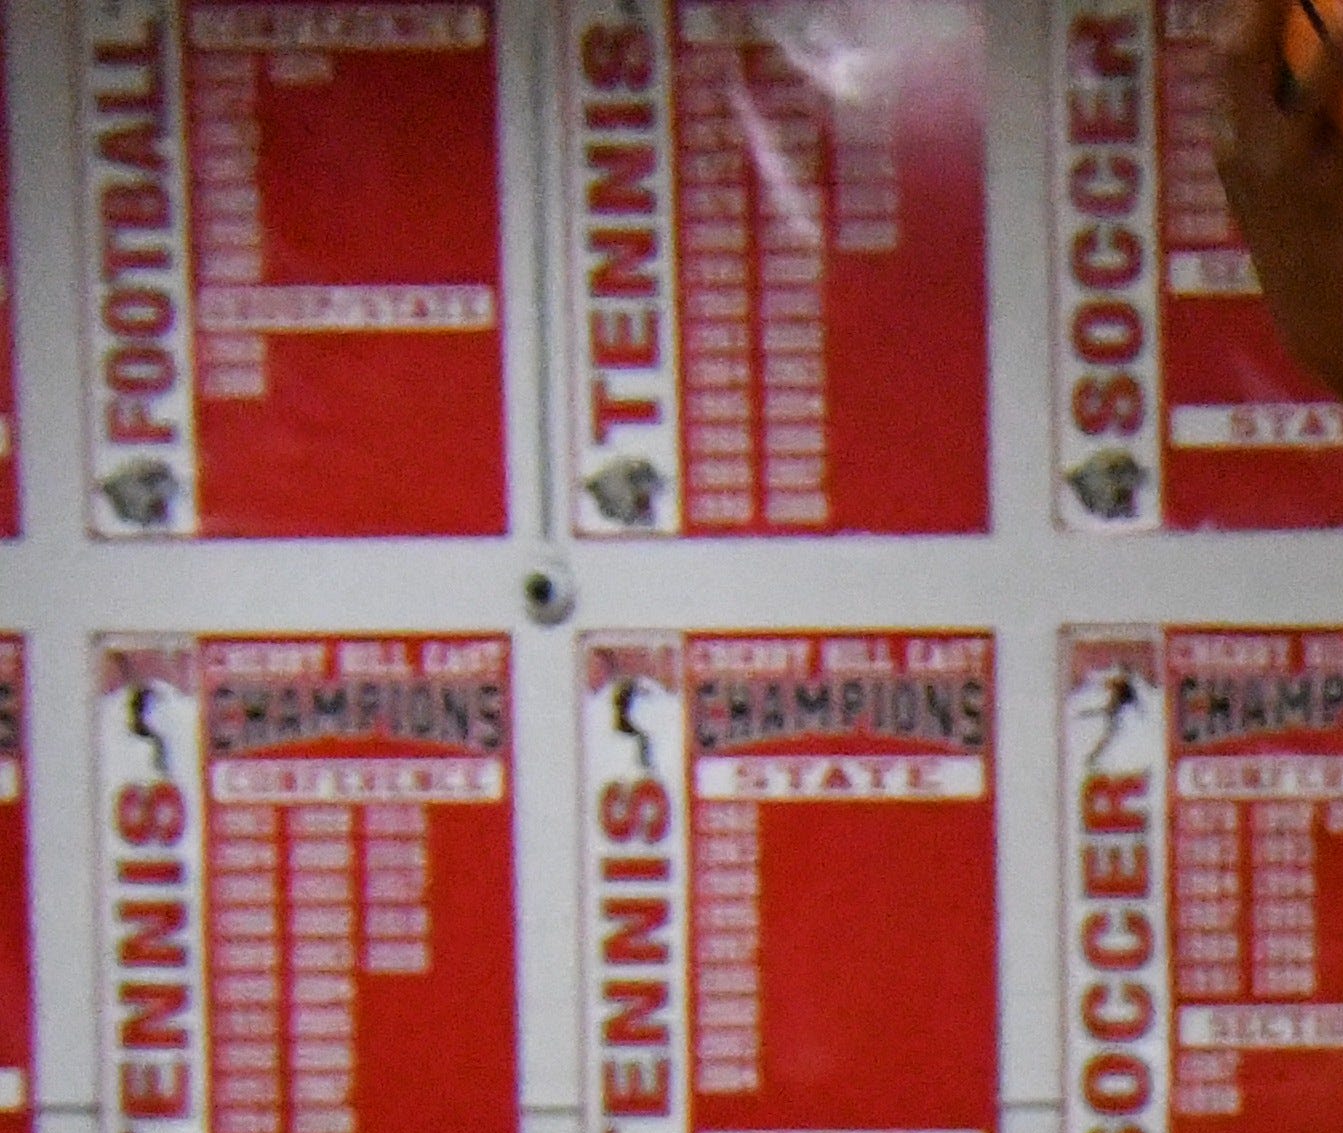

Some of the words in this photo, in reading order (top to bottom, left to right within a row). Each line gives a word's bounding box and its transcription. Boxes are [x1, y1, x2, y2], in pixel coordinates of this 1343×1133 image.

[92, 14, 178, 445] FOOTBALL
[579, 22, 662, 445] TENNIS
[1067, 13, 1147, 438] SOCCER
[207, 676, 503, 753] CHAMPIONS
[696, 675, 984, 752] CHAMPIONS
[733, 761, 943, 791] STATE
